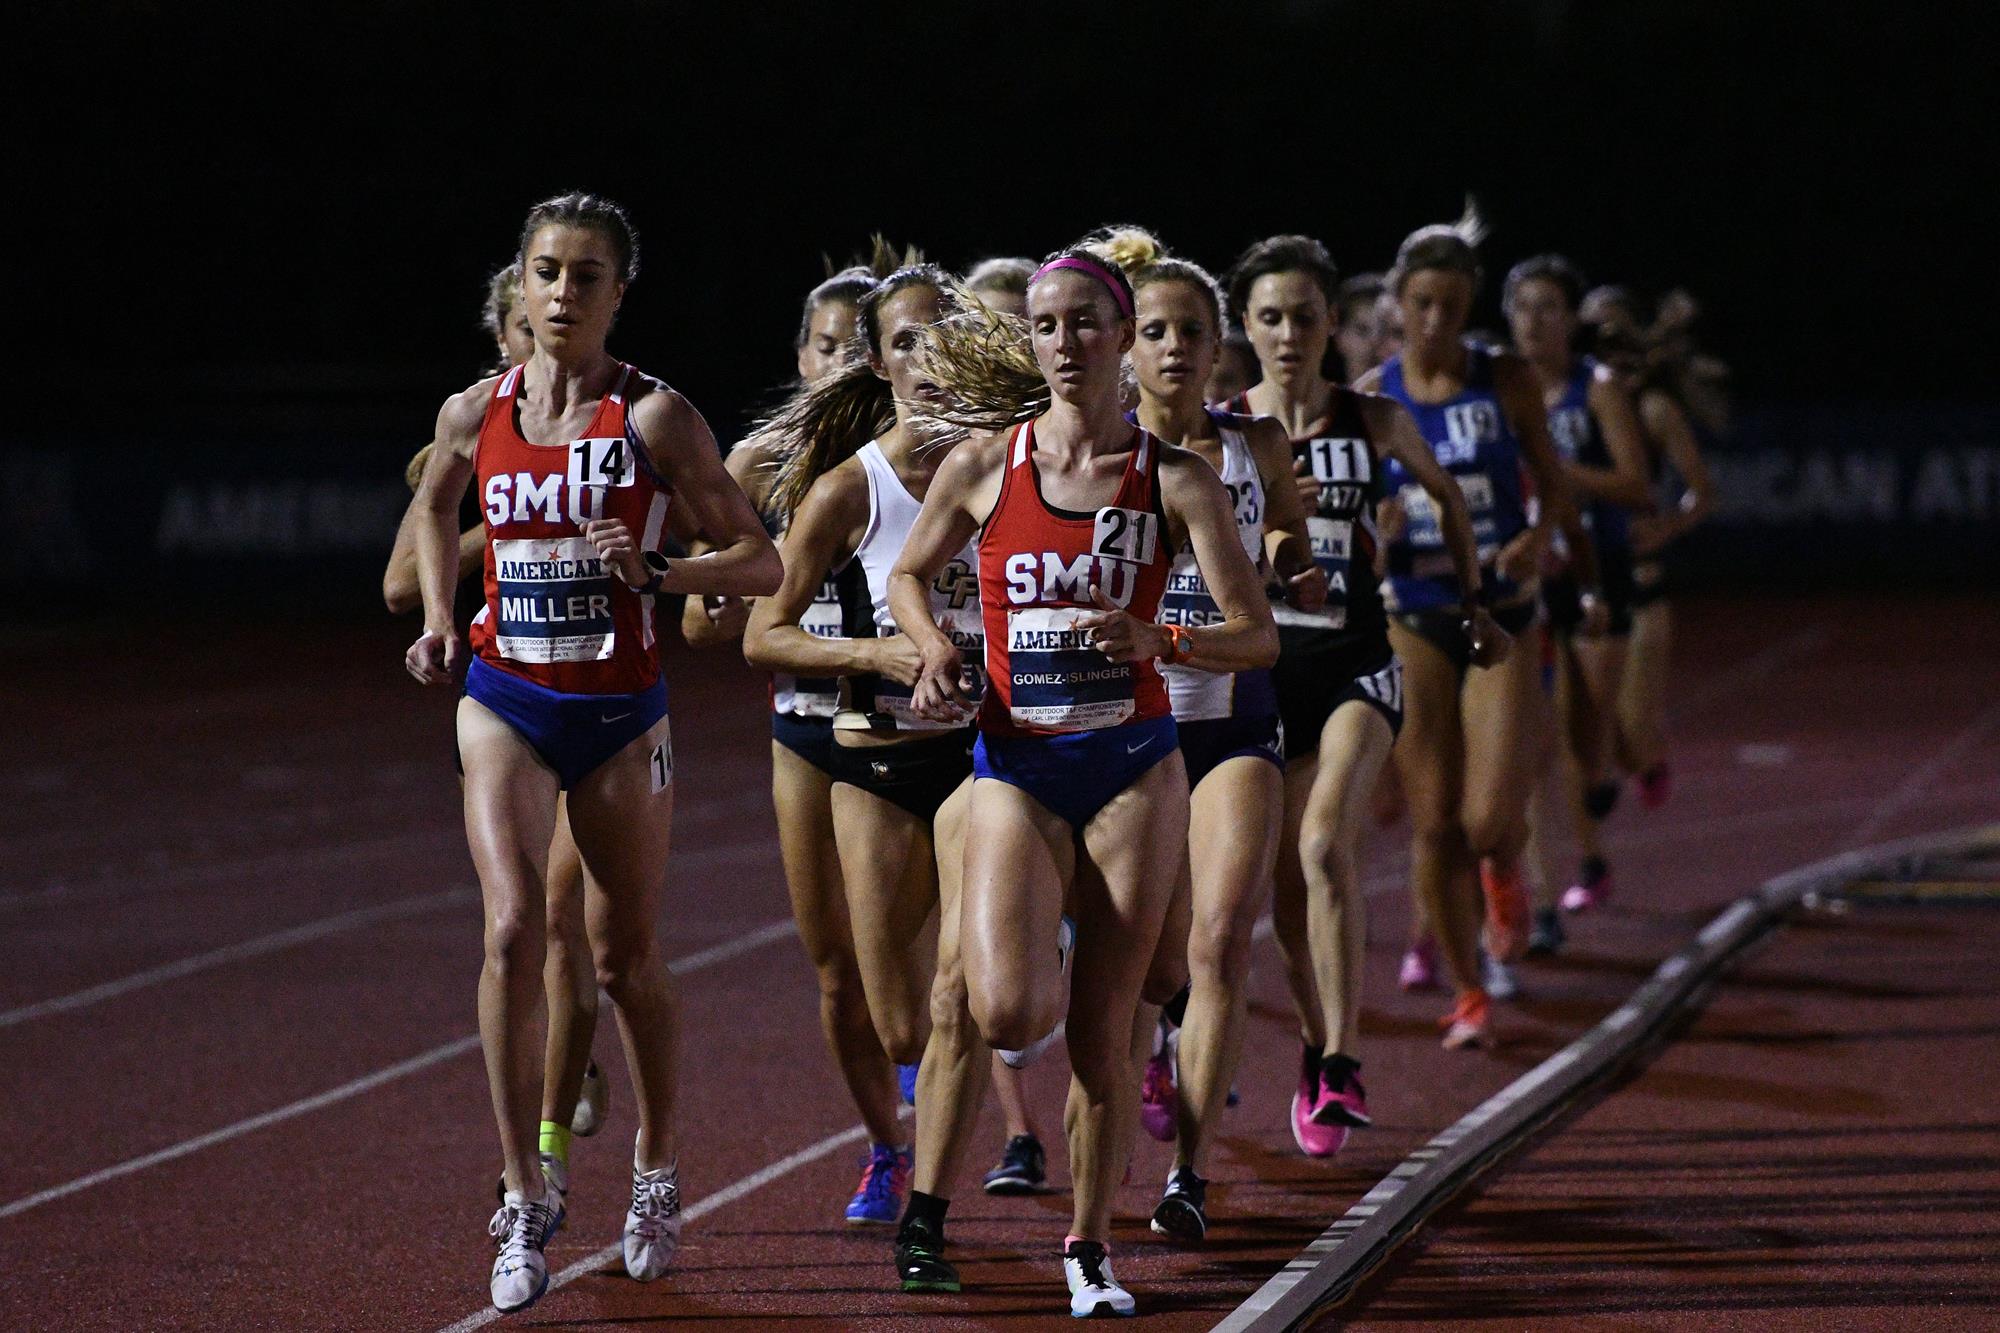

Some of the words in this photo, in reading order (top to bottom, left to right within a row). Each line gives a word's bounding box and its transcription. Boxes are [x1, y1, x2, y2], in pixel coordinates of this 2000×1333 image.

[574, 440, 626, 485] 14
[1317, 441, 1356, 478] 11
[485, 472, 607, 527] SMU
[1098, 508, 1148, 560] 21
[501, 558, 603, 580] AMERICAN
[1005, 552, 1138, 609] SMU
[502, 594, 611, 622] MILLER
[1013, 630, 1095, 650] AMERIC
[1013, 666, 1130, 686] GOMEZ-ISLINGER
[1035, 707, 1065, 715] OUTDOOR
[653, 736, 672, 787] 1
